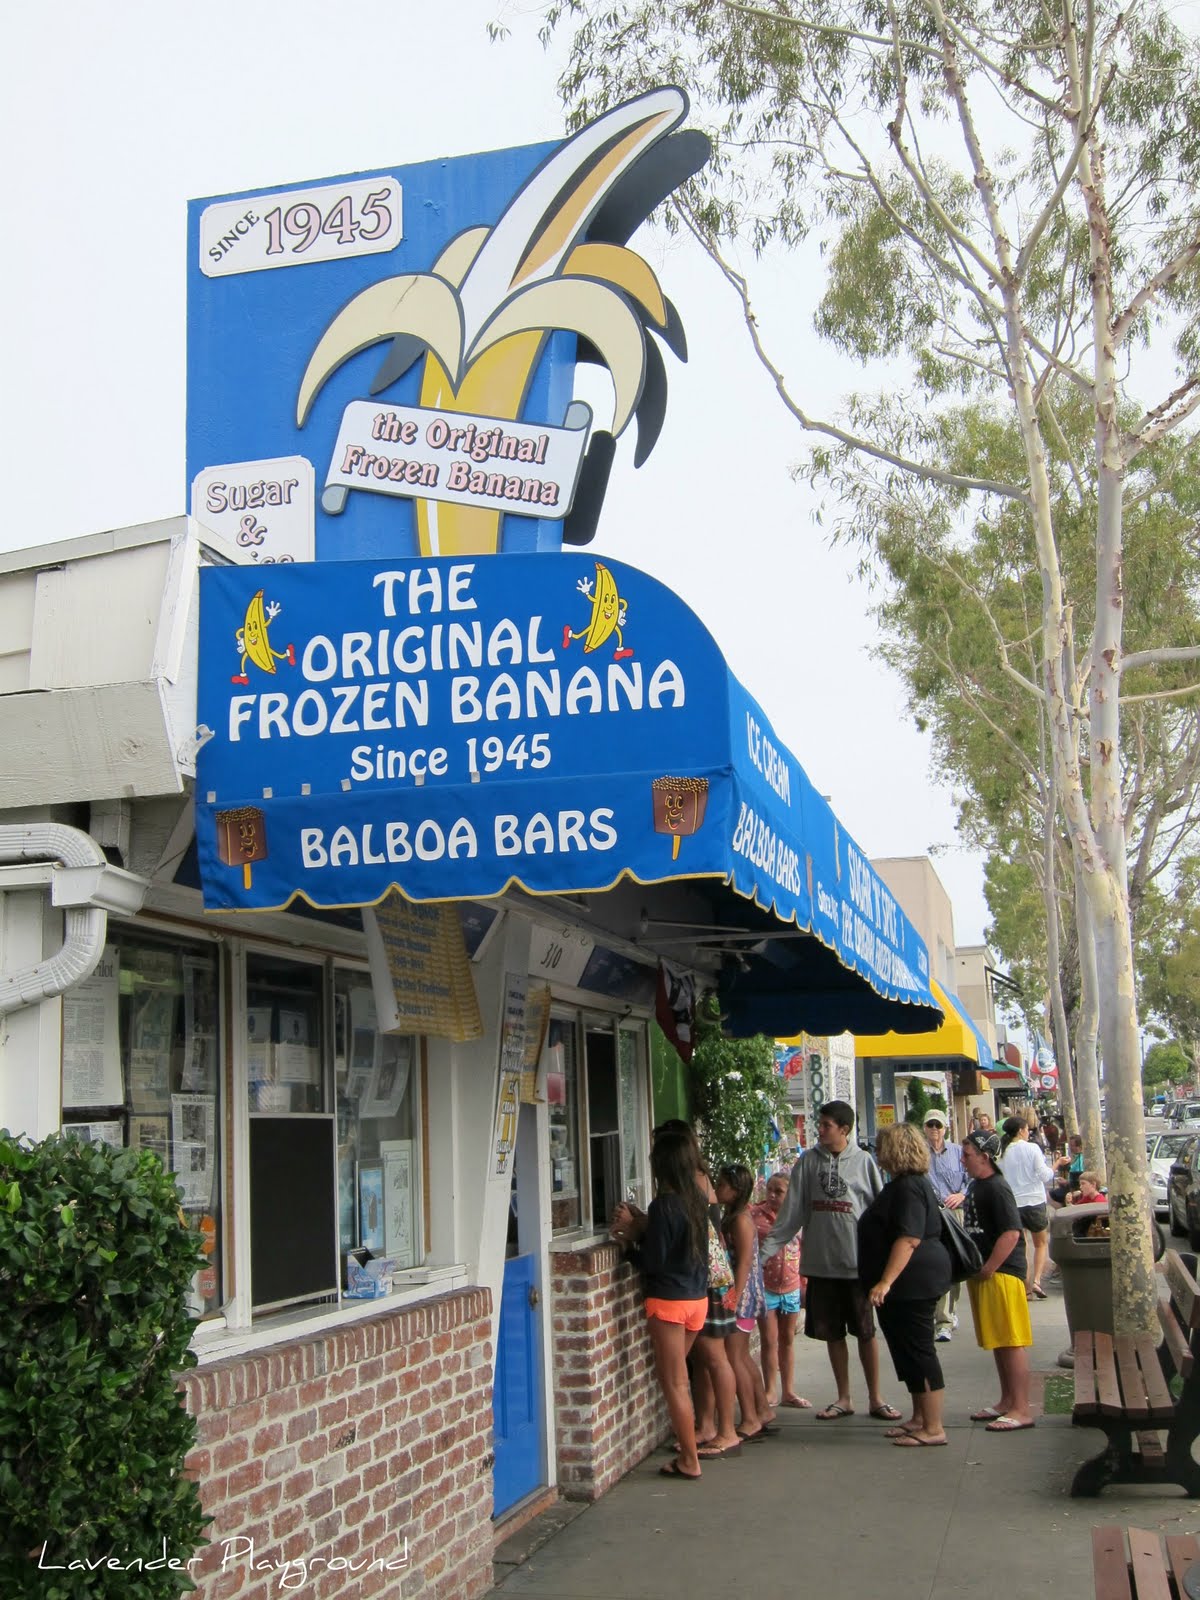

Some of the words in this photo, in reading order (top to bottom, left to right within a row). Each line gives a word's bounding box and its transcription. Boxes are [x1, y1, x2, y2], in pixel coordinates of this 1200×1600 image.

[209, 211, 260, 262] SINCE
[264, 188, 392, 255] 1945
[371, 412, 418, 444] the
[426, 418, 549, 464] Original
[206, 479, 299, 513] Sugar
[341, 444, 439, 487] Frozen
[447, 461, 559, 506] Banana
[236, 515, 267, 547] &
[372, 564, 478, 617] THE
[301, 616, 556, 682] ORIGINAL
[228, 680, 430, 742] FROZEN
[451, 659, 686, 723] BANANA
[350, 745, 448, 782] Since
[468, 733, 552, 773] 1945
[746, 711, 763, 774] ICE
[762, 735, 791, 807] CREAM
[300, 817, 478, 868] BALBOA
[494, 808, 617, 857] BARS
[732, 800, 776, 879] BALBOA
[775, 838, 801, 897] BARS
[92, 960, 113, 978] ilot
[541, 942, 563, 969] 310
